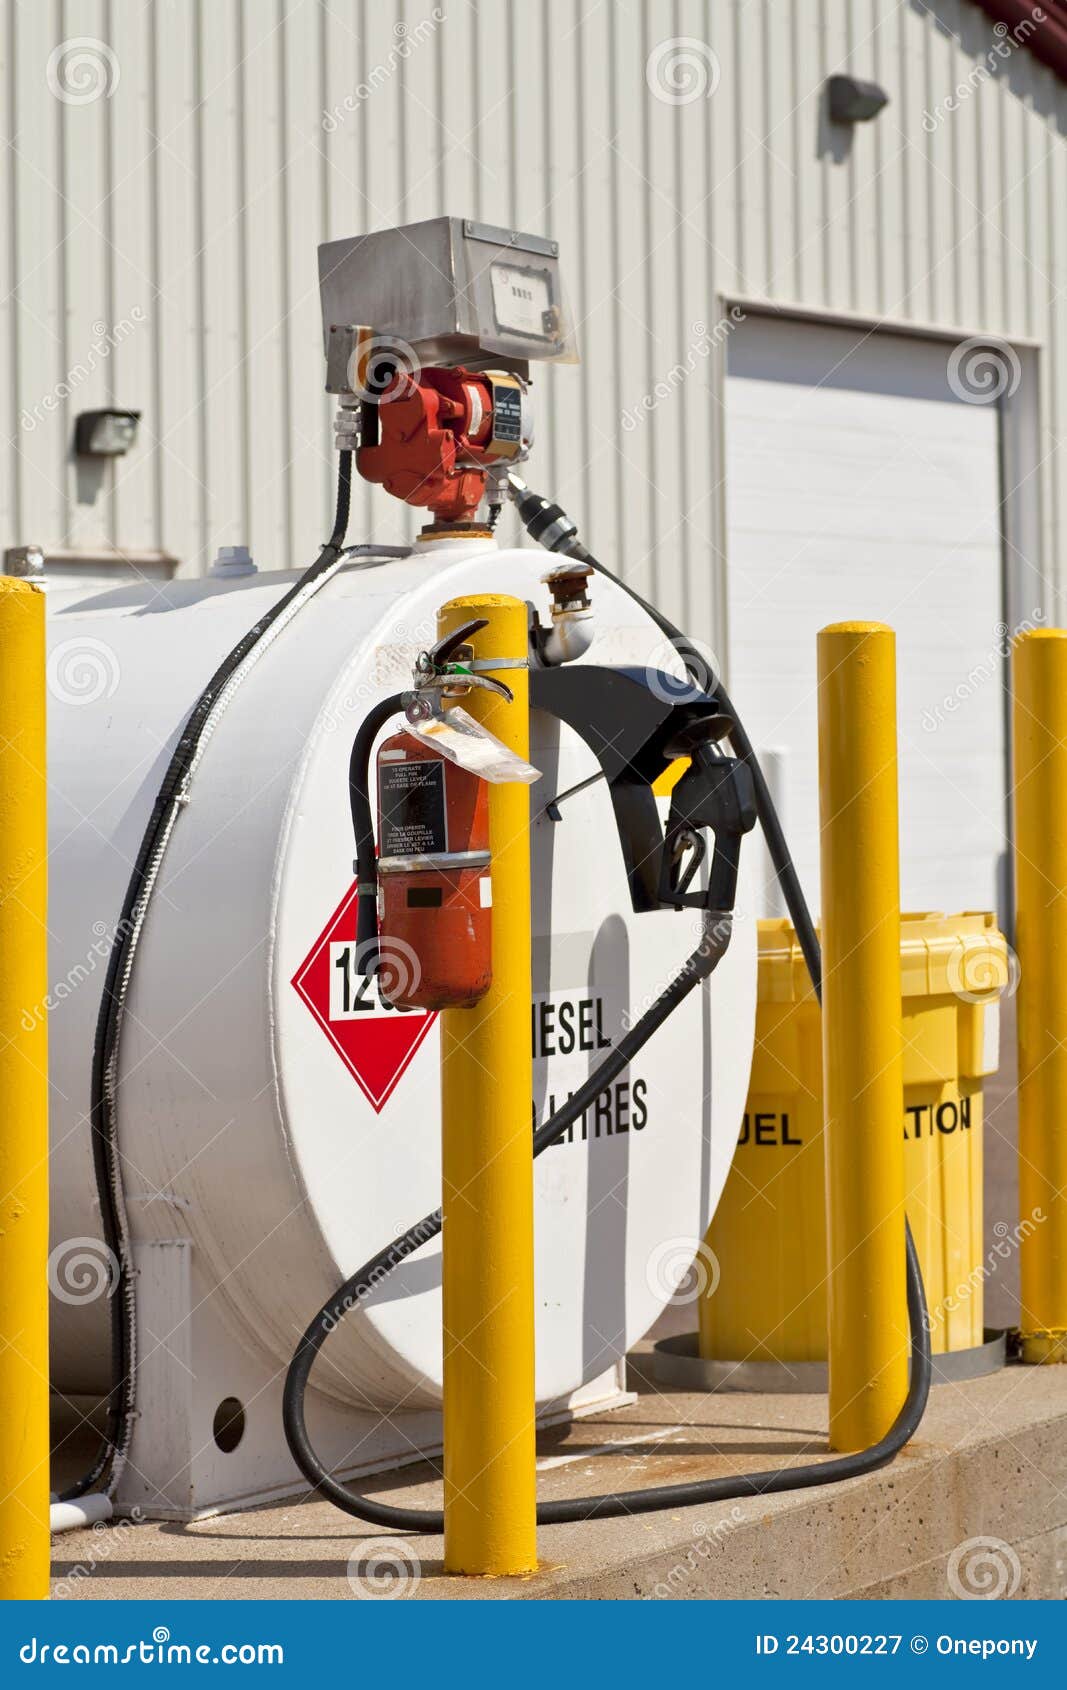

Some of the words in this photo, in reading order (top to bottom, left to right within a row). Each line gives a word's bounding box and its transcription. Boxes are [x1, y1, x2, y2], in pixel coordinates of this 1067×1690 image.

[336, 948, 394, 1012] 12
[532, 997, 612, 1059] IESEL
[904, 1096, 971, 1140] TION
